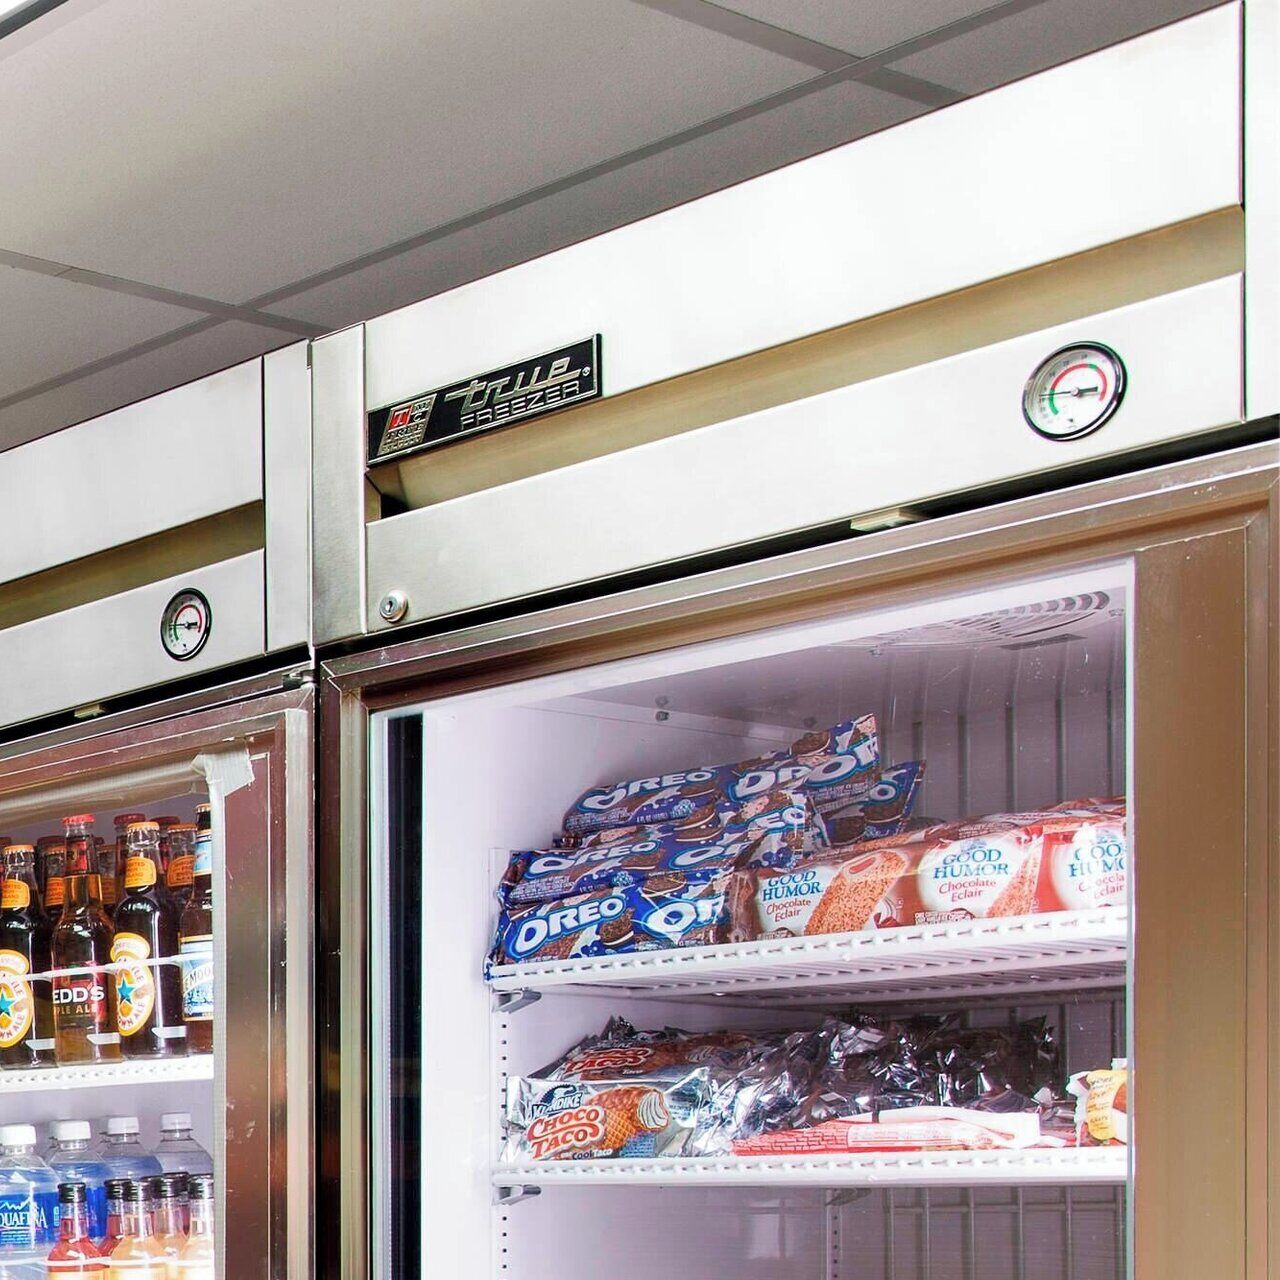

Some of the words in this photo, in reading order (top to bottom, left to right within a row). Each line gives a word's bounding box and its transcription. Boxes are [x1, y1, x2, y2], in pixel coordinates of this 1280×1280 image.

[460, 381, 580, 431] FREEZER
[582, 770, 713, 810] OREO
[528, 840, 658, 875] OREO
[943, 848, 1002, 865] GOOD
[933, 862, 1009, 879] HUMOR
[762, 881, 821, 901] HUMOR
[938, 878, 996, 894] Chocolate
[951, 887, 983, 902] Eclair
[766, 898, 812, 915] Chocolate
[774, 907, 801, 922] Eclair
[514, 896, 625, 955] OREO
[53, 985, 105, 1004] EDD'S
[75, 1003, 98, 1014] ALE
[528, 1108, 600, 1141] CHOCO
[531, 1126, 600, 1160] TACO
